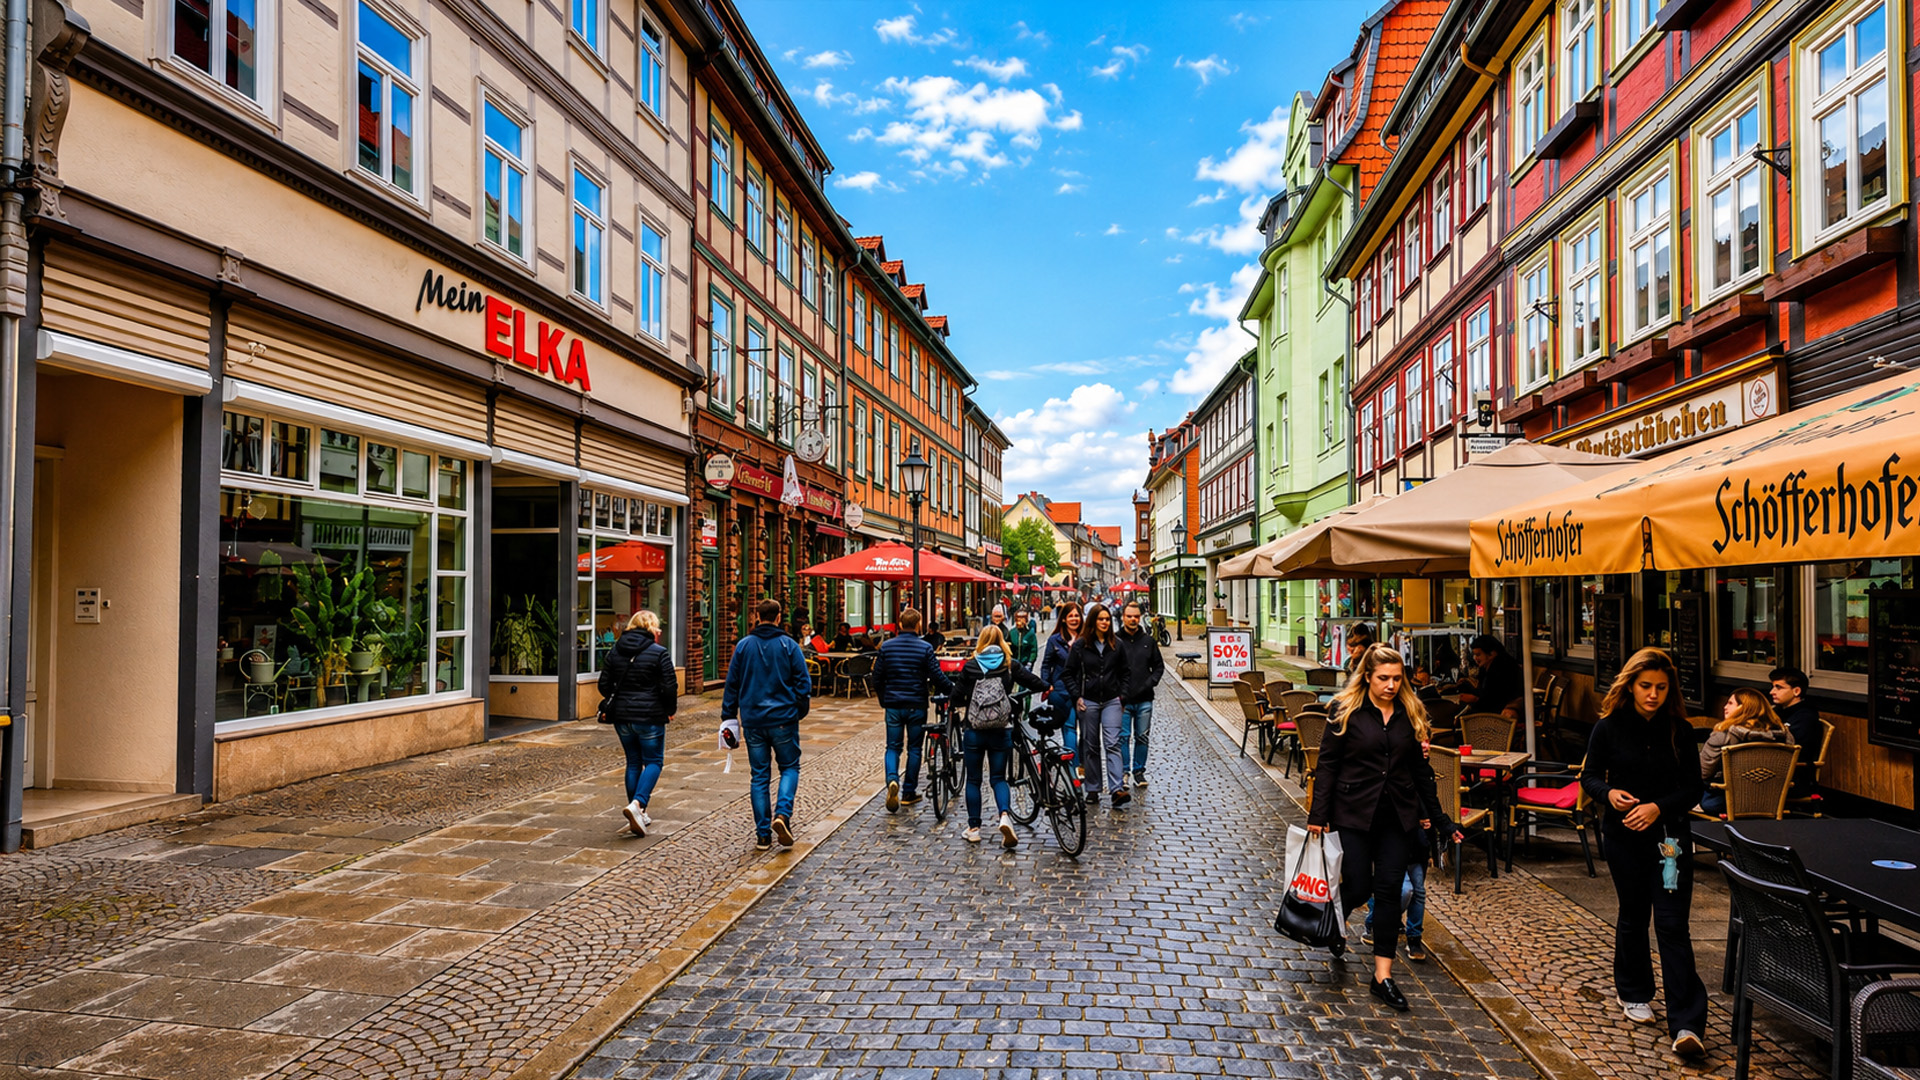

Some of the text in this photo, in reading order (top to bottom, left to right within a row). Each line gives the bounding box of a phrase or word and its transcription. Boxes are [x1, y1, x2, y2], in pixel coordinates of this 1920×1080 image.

[416, 269, 591, 391] Mein ELKA
[1495, 509, 1584, 568] Schöfferhofer
[1712, 452, 1920, 555] Schöfferhofe
[1213, 644, 1248, 658] 50%
